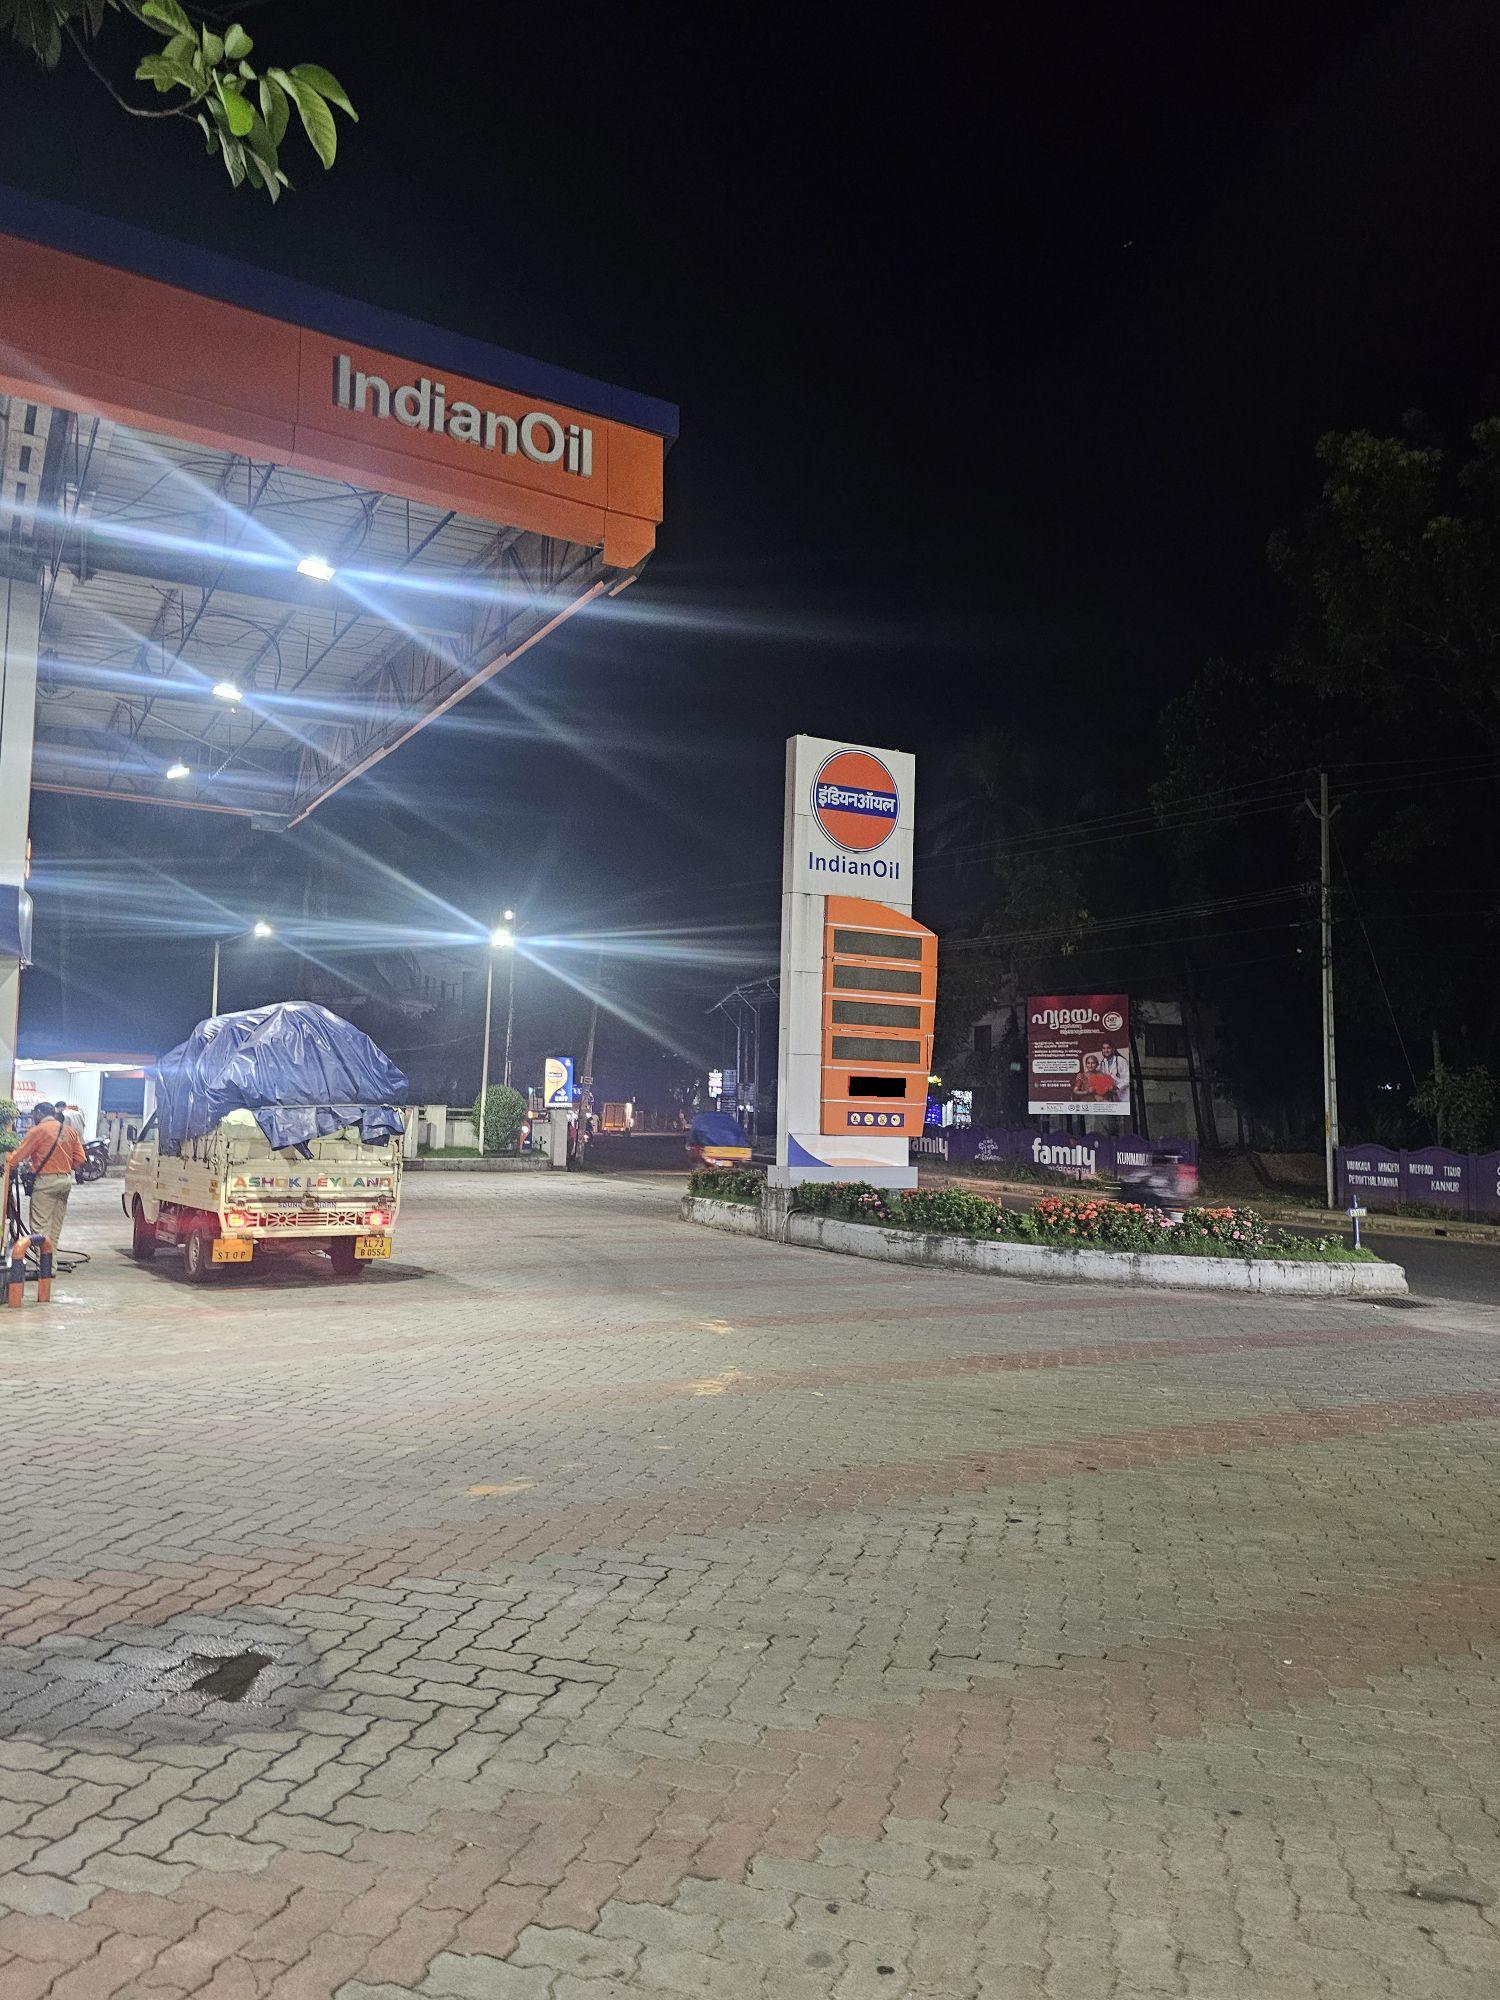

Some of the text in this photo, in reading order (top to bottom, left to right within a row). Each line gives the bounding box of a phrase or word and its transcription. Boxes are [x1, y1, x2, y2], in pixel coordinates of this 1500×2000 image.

[334, 354, 593, 478] IndianOil
[818, 785, 896, 813] इंडियनऑयल
[809, 852, 899, 879] IndianOil
[909, 1137, 948, 1161] amily
[1032, 1137, 1096, 1174] family
[233, 1176, 392, 1188] ASHOK LEYLAND
[1431, 1180, 1460, 1192] KANNUR
[374, 1237, 384, 1248] 73
[217, 1251, 246, 1260] STOP
